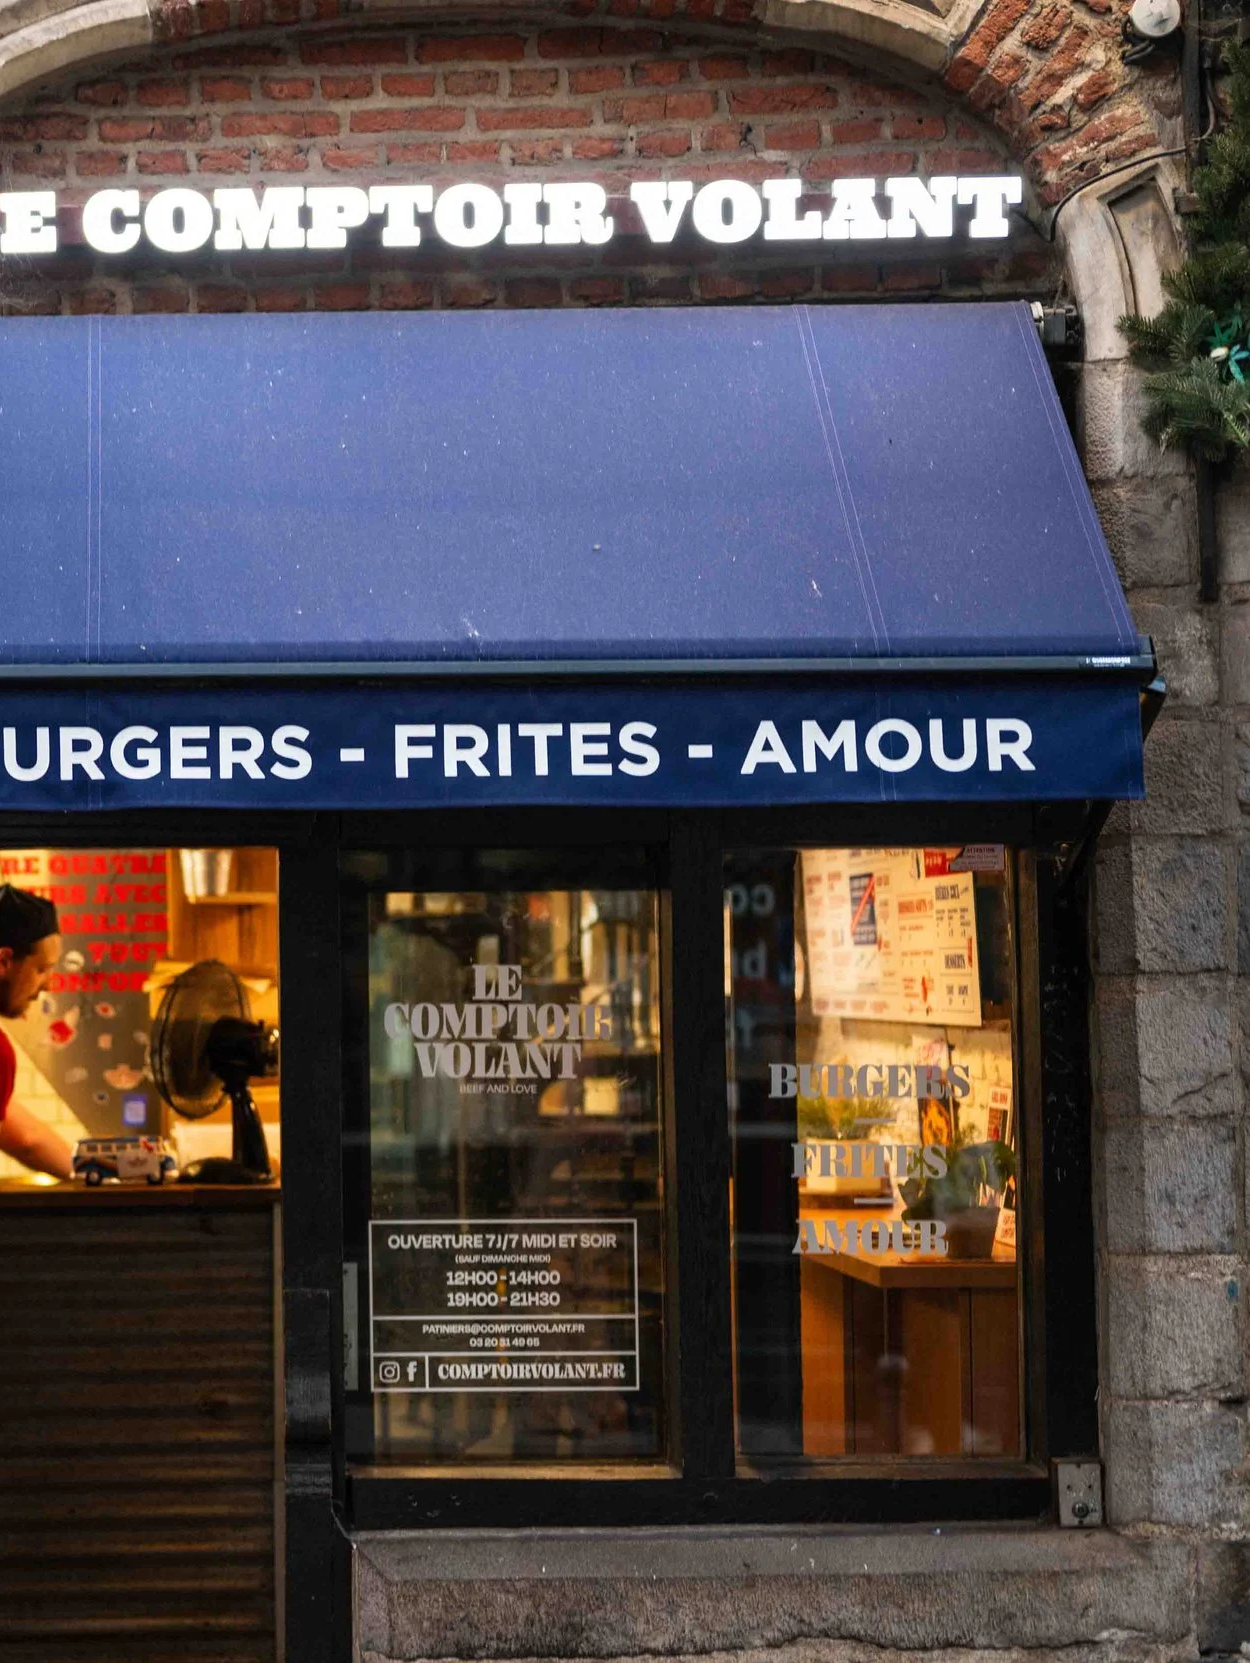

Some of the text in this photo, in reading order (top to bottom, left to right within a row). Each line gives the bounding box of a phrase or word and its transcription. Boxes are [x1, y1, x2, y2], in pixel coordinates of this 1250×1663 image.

[82, 182, 614, 254] COMPTOIR
[630, 176, 1022, 243] VOLANT
[395, 721, 660, 778] FRITES
[741, 718, 1036, 776] AMOUR
[50, 855, 167, 877] QUATRE
[472, 964, 523, 1000] LE
[383, 1002, 613, 1041] COMPTOIR
[414, 1042, 582, 1079] VOLANT
[459, 1083, 538, 1094] BEEF AND LOVE
[768, 1063, 971, 1099] BURGERS
[790, 1143, 948, 1178] FRITES
[388, 1233, 617, 1251] OUVERTURE 7J/7 MIDI ET SOIR
[792, 1220, 949, 1255] AMOUR
[482, 1254, 528, 1264] DIMANCHE
[446, 1271, 498, 1286] 12H00
[509, 1271, 560, 1285] 14H00
[447, 1292, 498, 1307] 19H00
[510, 1292, 560, 1307] 21H30
[422, 1324, 585, 1335] PATINIERS@COMPTOIRVOLANT.FR
[470, 1338, 483, 1348] 03
[437, 1362, 626, 1381] COMPTOIRVOLANT.FR
